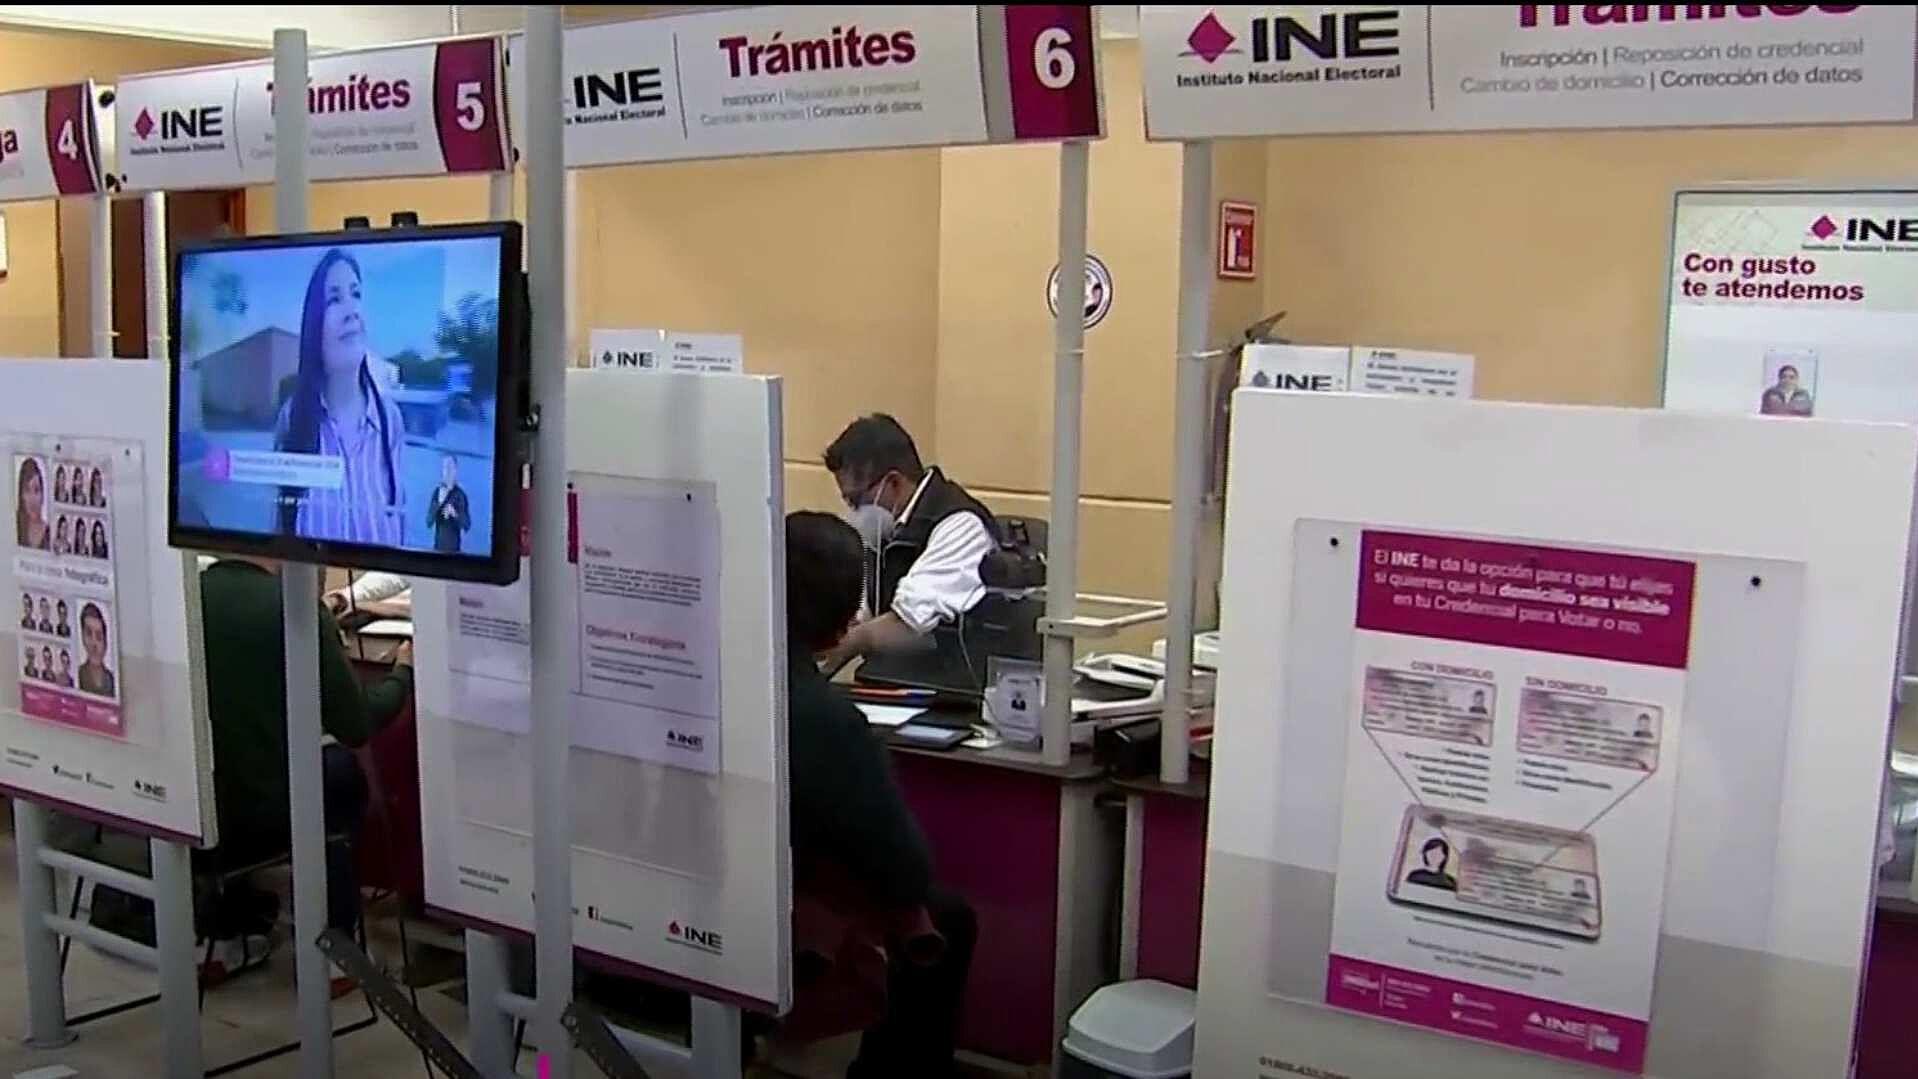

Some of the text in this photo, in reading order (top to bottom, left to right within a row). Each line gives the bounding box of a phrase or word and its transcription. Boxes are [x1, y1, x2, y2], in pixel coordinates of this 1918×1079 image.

[719, 25, 916, 78] Trámites
[1253, 10, 1399, 62] INE
[1034, 27, 1075, 89] 6
[1501, 37, 1864, 68] Inscripción Reposición de credencial
[574, 68, 663, 108] INE
[1177, 64, 1400, 88] Instituto Nacional Electoral
[1660, 68, 1767, 88] Corrección
[1773, 66, 1799, 85] de
[1805, 65, 1863, 84] datos
[456, 81, 485, 131] 5
[161, 106, 223, 139] INE
[58, 119, 78, 160] 4
[1683, 253, 1816, 279] Con gusto
[1682, 278, 1864, 300] te atendemos
[617, 351, 653, 368] INE
[1275, 373, 1332, 391] INE
[1374, 549, 1389, 565] El
[1391, 551, 1421, 567] INE
[1440, 557, 1461, 572] da
[1535, 568, 1573, 585] para
[1603, 617, 1616, 630] o
[684, 925, 723, 950] INE
